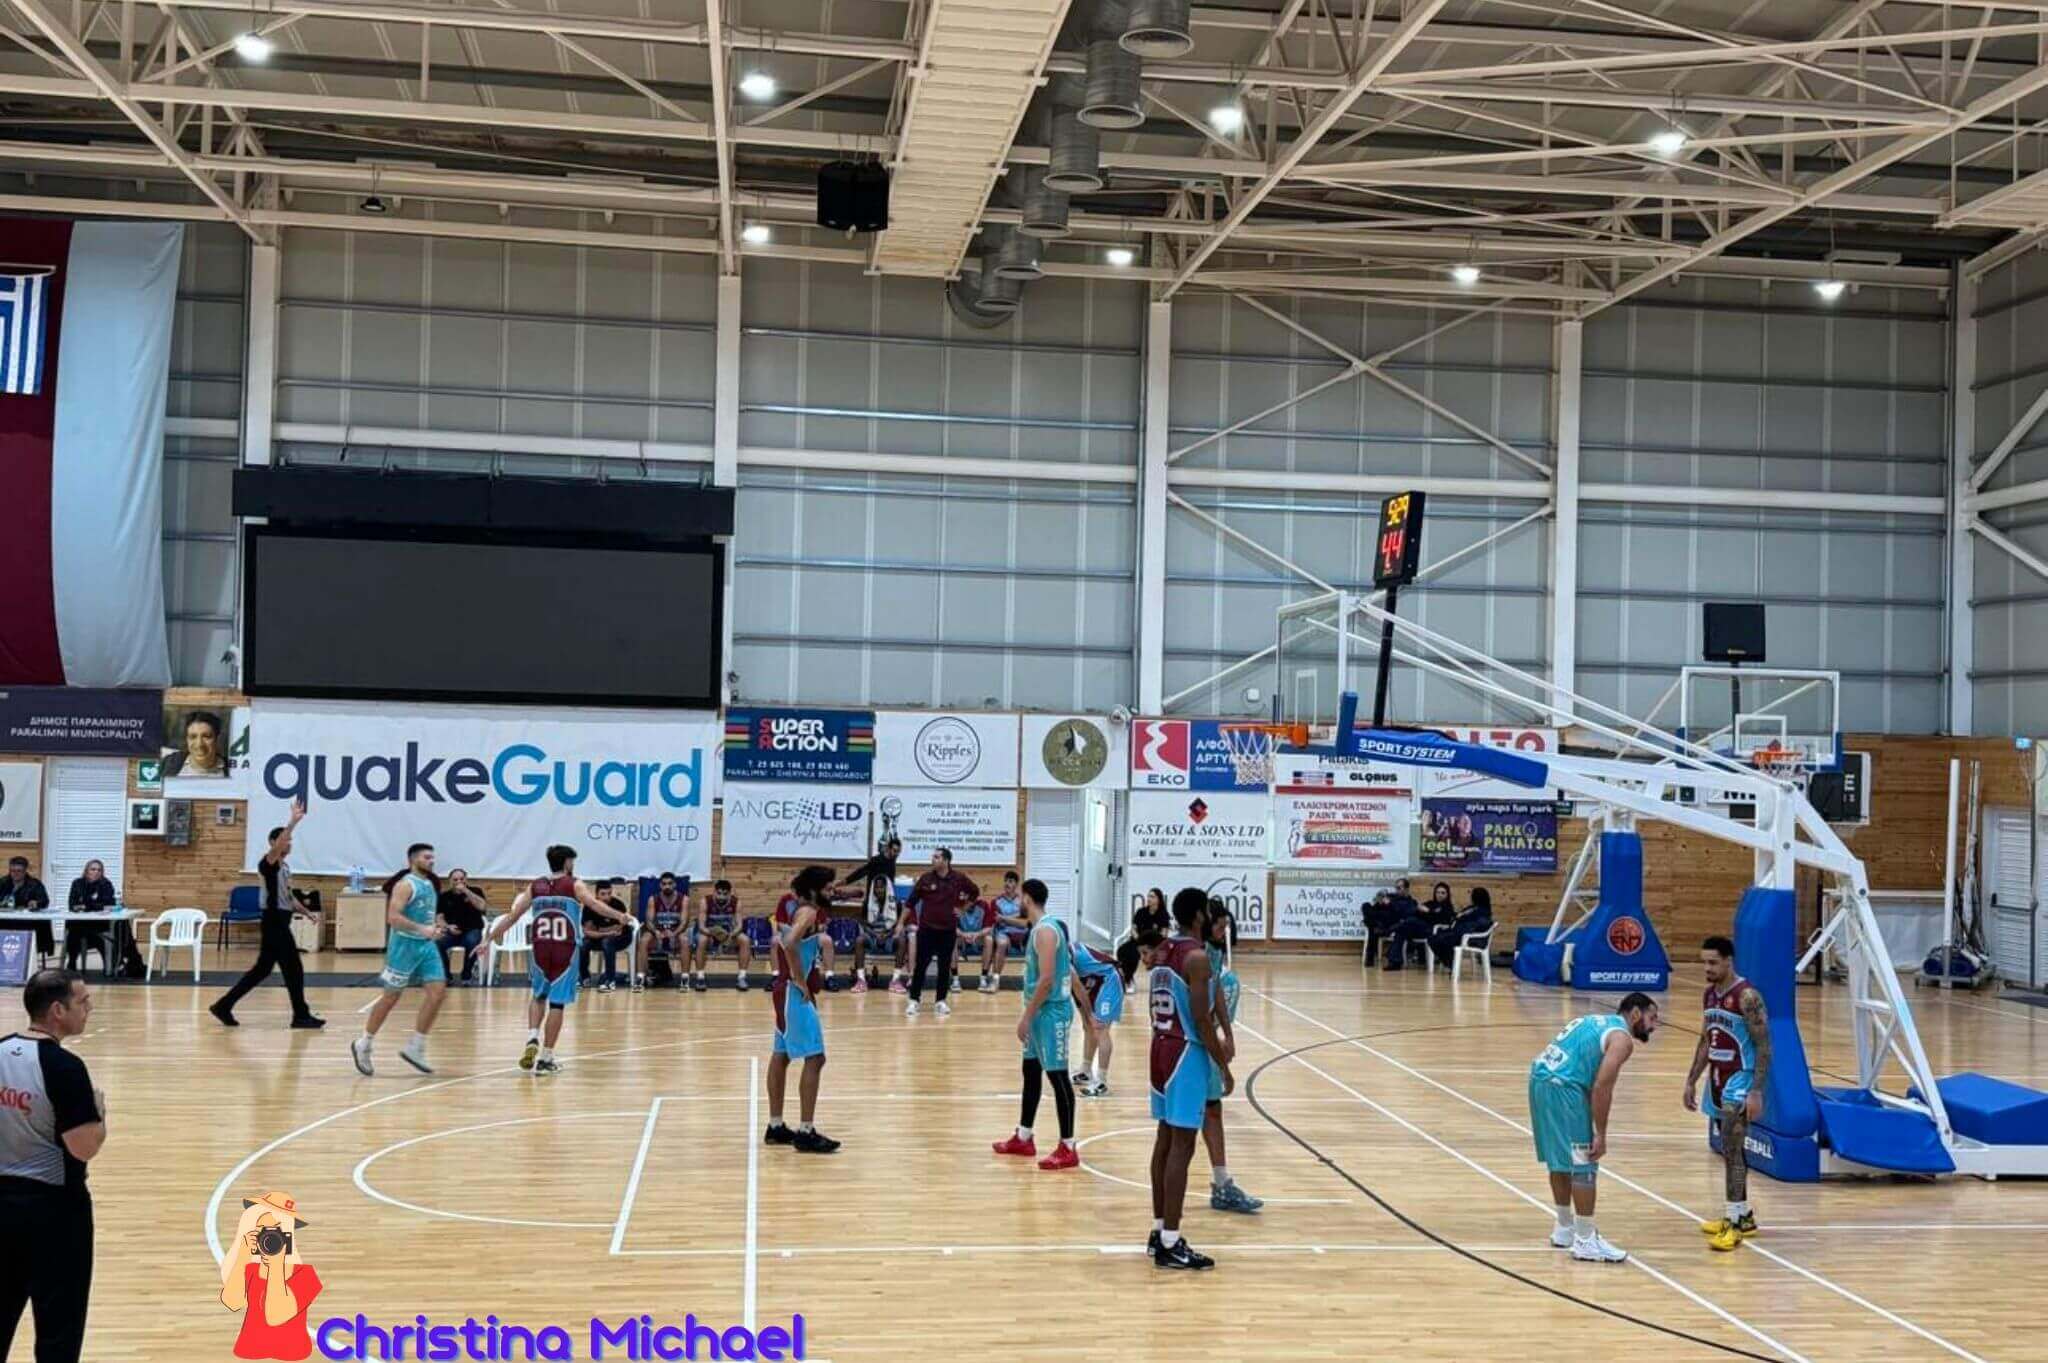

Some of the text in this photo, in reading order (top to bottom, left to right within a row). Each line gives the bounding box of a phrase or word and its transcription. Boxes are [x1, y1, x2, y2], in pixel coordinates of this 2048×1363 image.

[11, 727, 144, 739] PARALIMNI MUNICIPALITY
[760, 717, 824, 734] SUPER
[758, 734, 838, 752] ACTION
[263, 741, 703, 814] quakeGuard
[1147, 774, 1185, 785] EKO
[587, 823, 699, 842] CYPRUS LTD
[1187, 824, 1197, 836] &
[1200, 825, 1237, 837] SONS
[1239, 825, 1265, 837] LTD
[537, 917, 567, 940] 20
